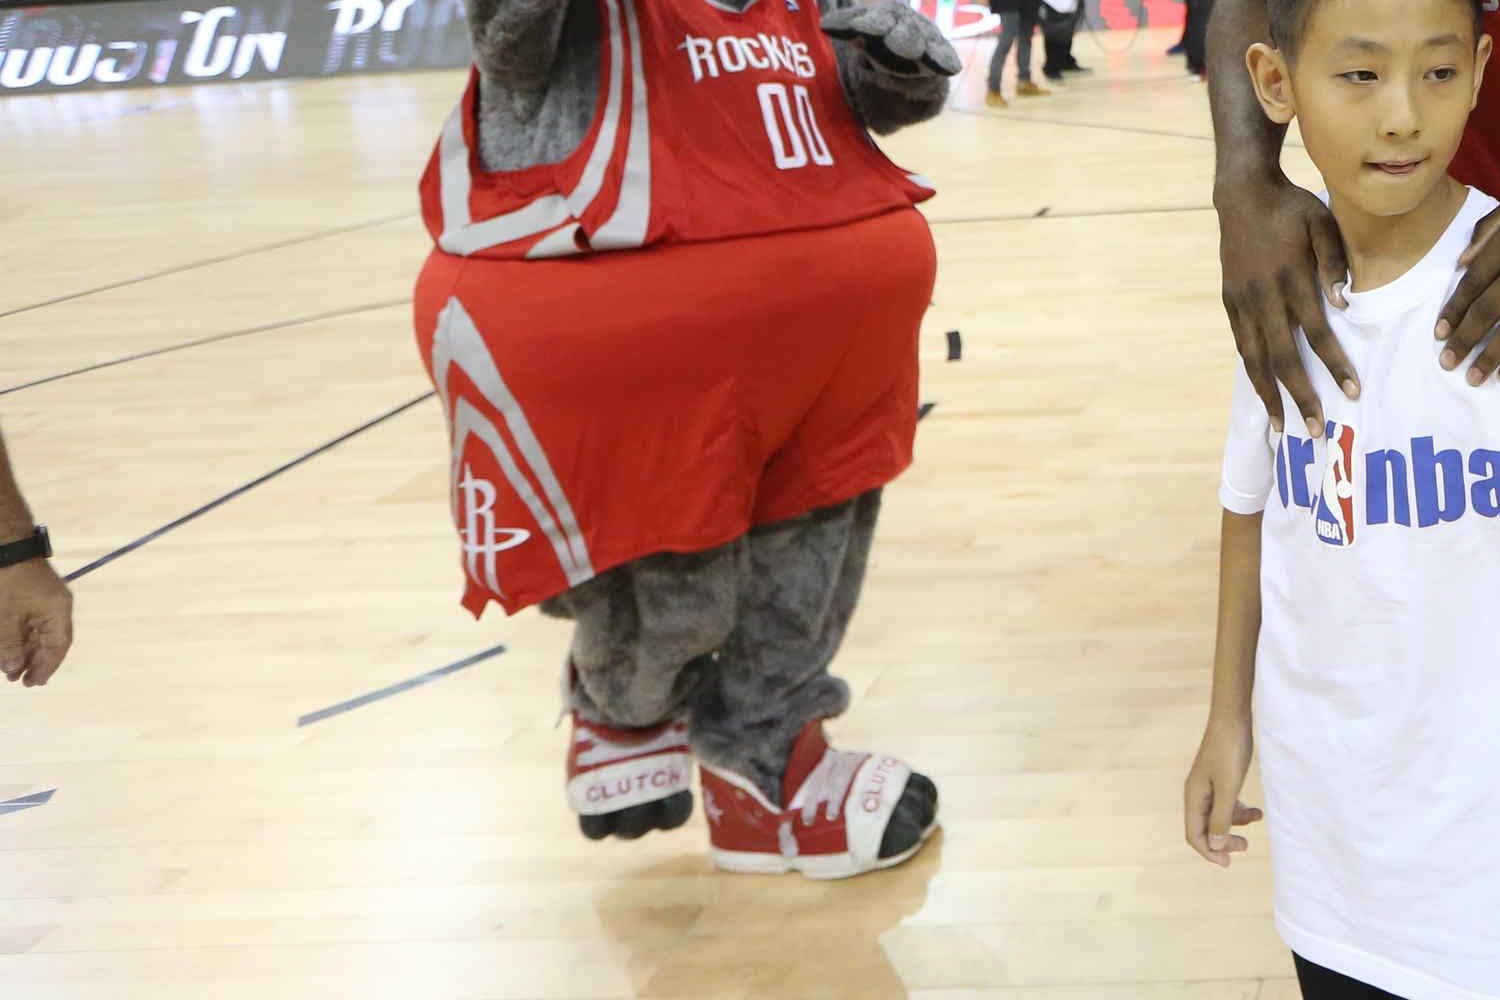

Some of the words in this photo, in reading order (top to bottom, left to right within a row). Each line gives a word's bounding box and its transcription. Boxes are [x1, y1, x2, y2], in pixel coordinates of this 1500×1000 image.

[756, 82, 835, 170] 00
[1316, 519, 1341, 540] NBA
[585, 766, 681, 803] CLUTCH
